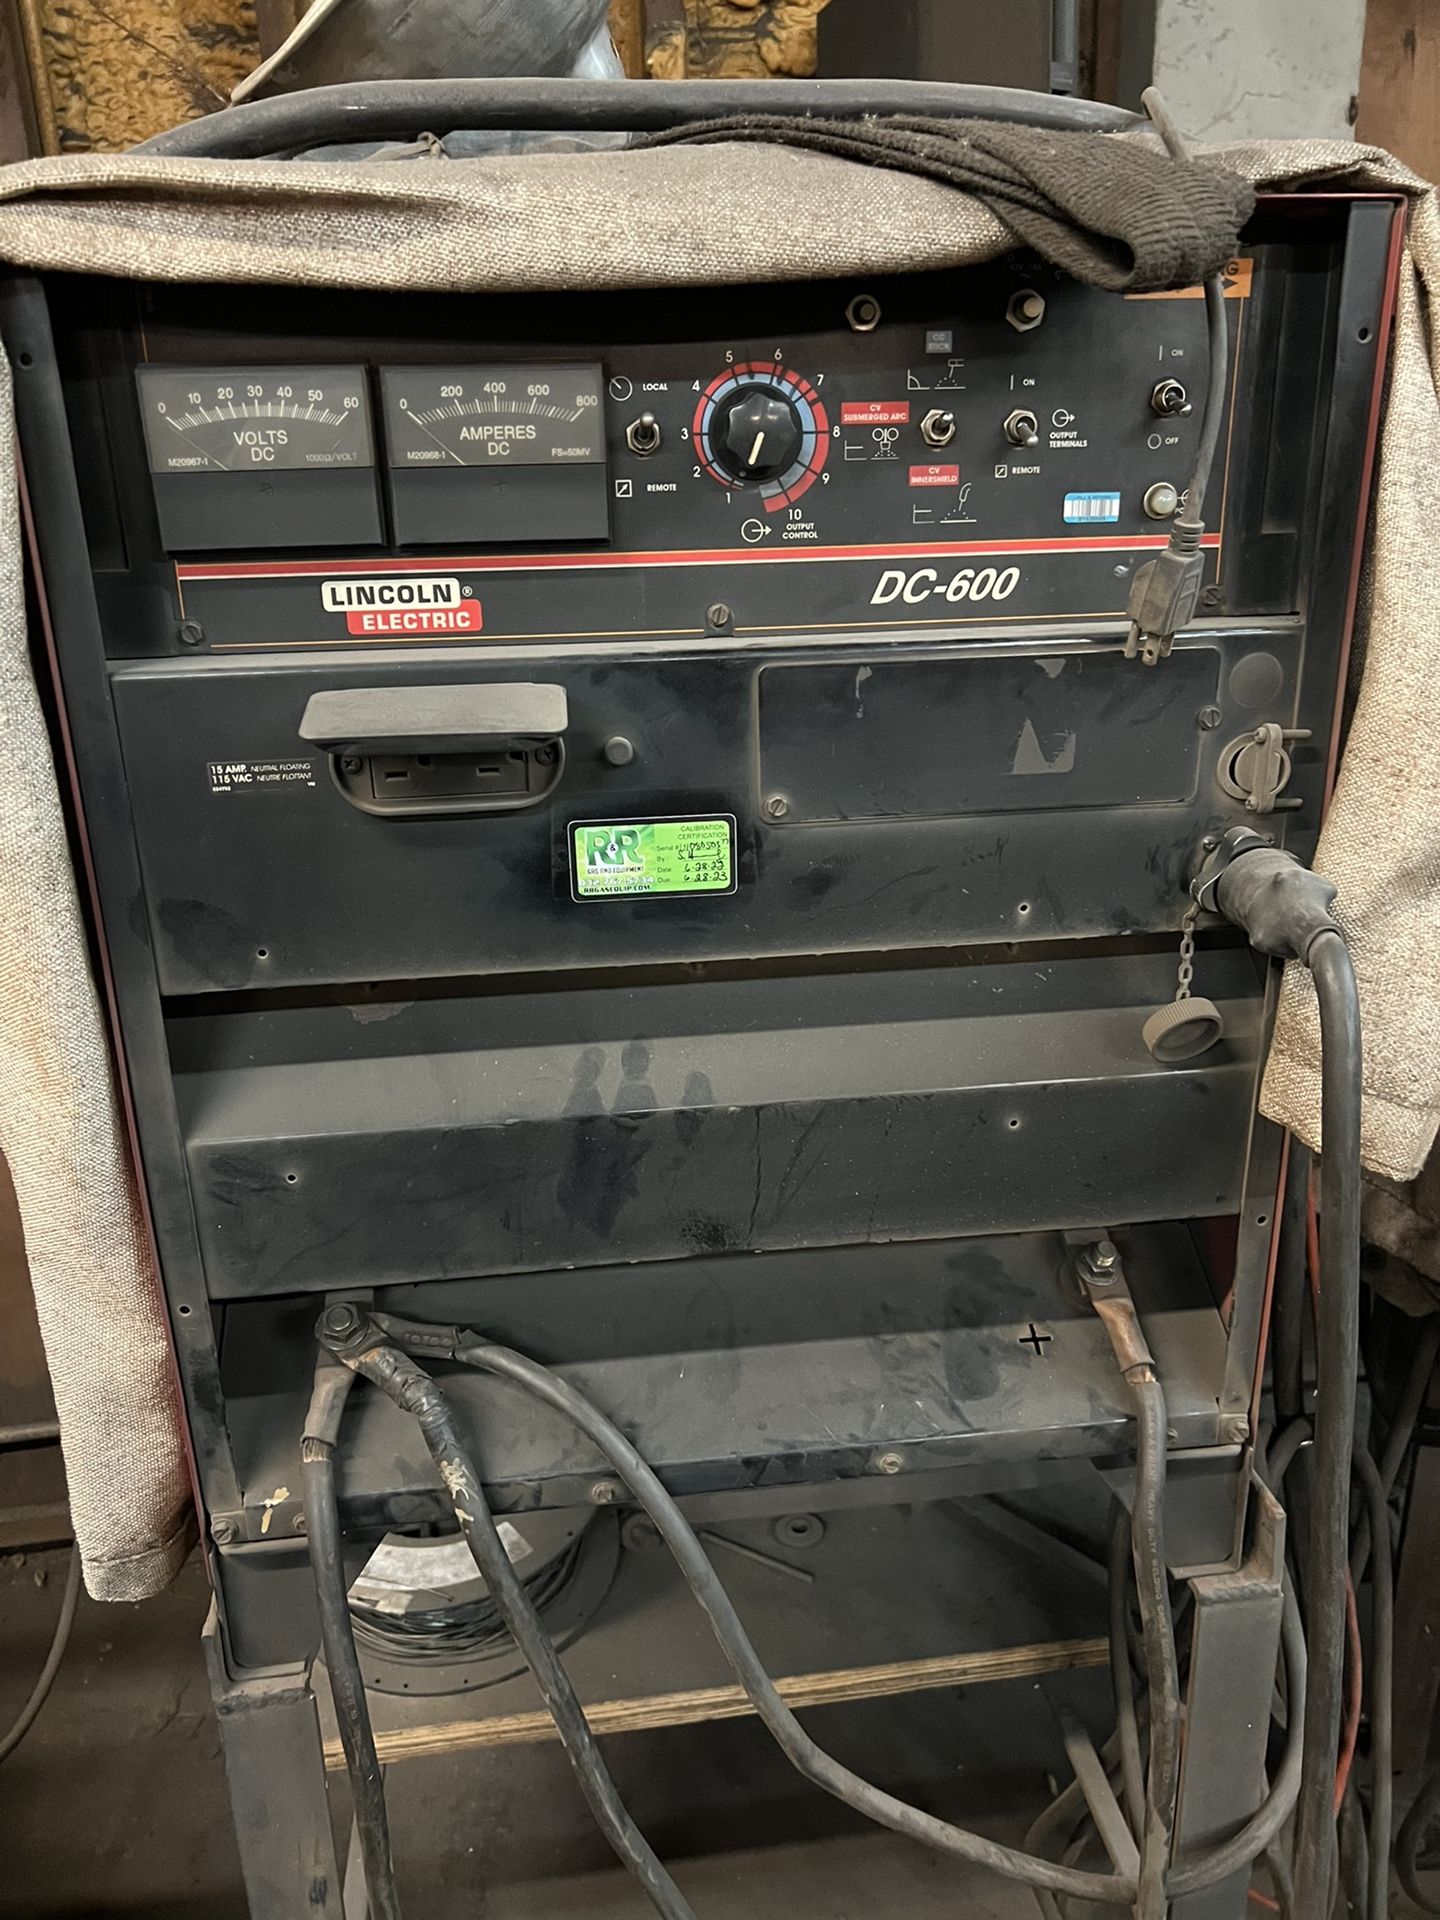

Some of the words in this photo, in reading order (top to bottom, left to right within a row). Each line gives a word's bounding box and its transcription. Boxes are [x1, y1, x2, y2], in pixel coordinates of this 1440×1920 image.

[726, 351, 734, 362] 5
[774, 349, 782, 360] 6
[692, 380, 700, 392] 4
[817, 374, 825, 386] 7
[642, 382, 668, 392] LOCAL
[157, 402, 166, 413] 0
[188, 392, 202, 404] 10
[217, 388, 234, 400] 20
[247, 386, 263, 398] 30
[276, 386, 292, 398] 40
[308, 390, 323, 401] 50
[344, 397, 359, 408] 60
[399, 398, 408, 410] 0
[440, 386, 463, 397] 200
[484, 382, 506, 394] 400
[528, 384, 550, 396] 600
[576, 395, 598, 406] 800
[870, 404, 882, 412] CV
[844, 413, 889, 422] SUBMERGED
[890, 412, 907, 420] ARC
[460, 425, 536, 441] AMPERES
[680, 428, 689, 440] 3
[832, 426, 841, 437] 8
[1050, 432, 1078, 440] OUTPUT
[233, 430, 288, 446] VOLTS
[1049, 440, 1088, 448] TERMINALS
[250, 448, 275, 462] DC
[488, 442, 510, 456] DC
[692, 466, 701, 478] 2
[1012, 466, 1040, 474] REMOTE
[822, 472, 830, 484] 9
[911, 475, 958, 483] INNERSHIELD
[646, 483, 677, 492] REMOTE
[726, 492, 731, 504] 1
[788, 509, 802, 520] 10
[782, 532, 818, 540] CONTROL
[870, 567, 1020, 605] DC-600
[330, 584, 452, 606] LINCOLN
[362, 611, 471, 631] ELECTRIC
[211, 766, 224, 774] 15
[225, 764, 248, 774] AMP.
[250, 764, 279, 772] NEUTRAL
[280, 762, 312, 770] FLOATING
[212, 775, 231, 784] 115
[232, 774, 252, 783] VAC
[256, 774, 281, 782] NEUTRE
[282, 772, 312, 780] FLOTTANT
[680, 824, 724, 832] CALIBRATION
[677, 832, 728, 840] CERTIFICATION
[1147, 1489, 1157, 1521] HEAVY
[1146, 1528, 1157, 1554] DUTY
[1151, 1558, 1163, 1600] WELDING
